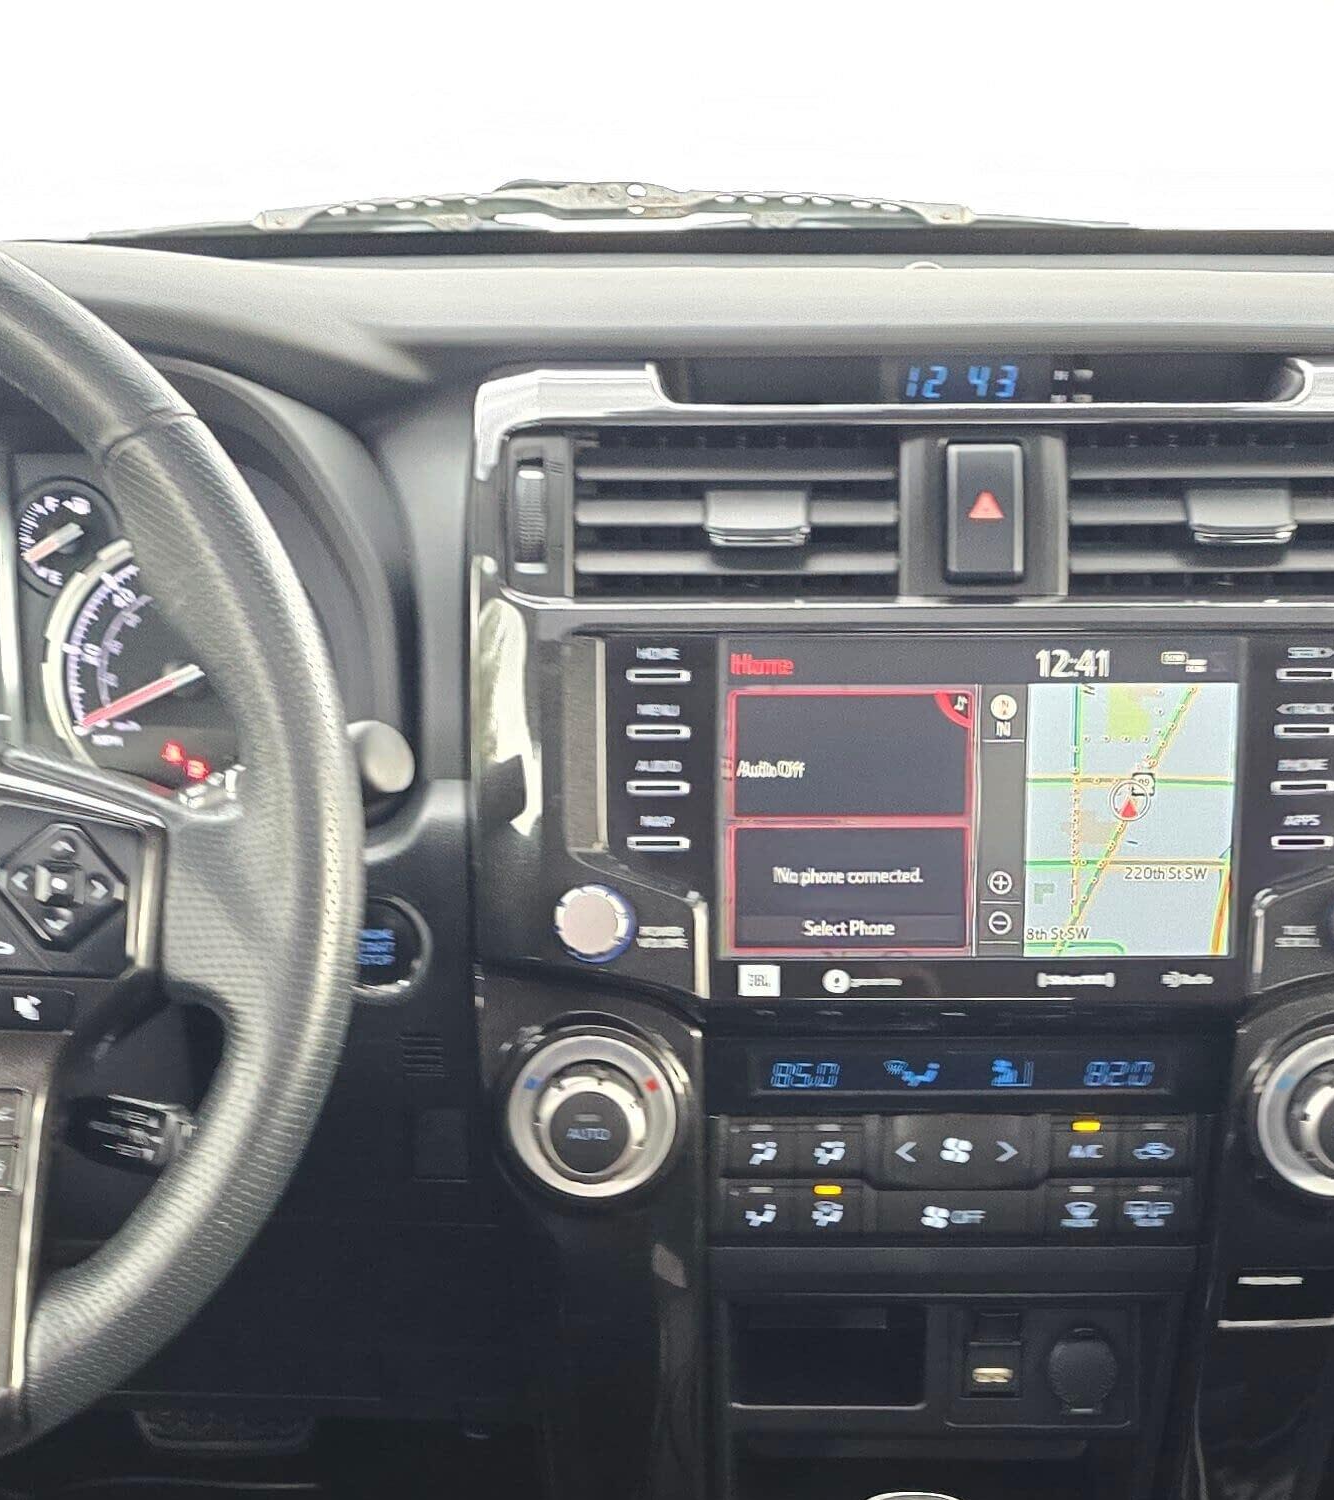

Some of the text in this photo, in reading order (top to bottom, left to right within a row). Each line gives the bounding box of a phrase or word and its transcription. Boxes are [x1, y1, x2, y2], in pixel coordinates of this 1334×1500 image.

[730, 653, 795, 675] Home
[1036, 649, 1111, 678] 12:41
[736, 760, 806, 778] Audio Off
[772, 866, 923, 887] No phone connected.
[1124, 866, 1208, 880] 220th St SW
[803, 919, 896, 937] Select Phone
[1067, 927, 1090, 941] SW
